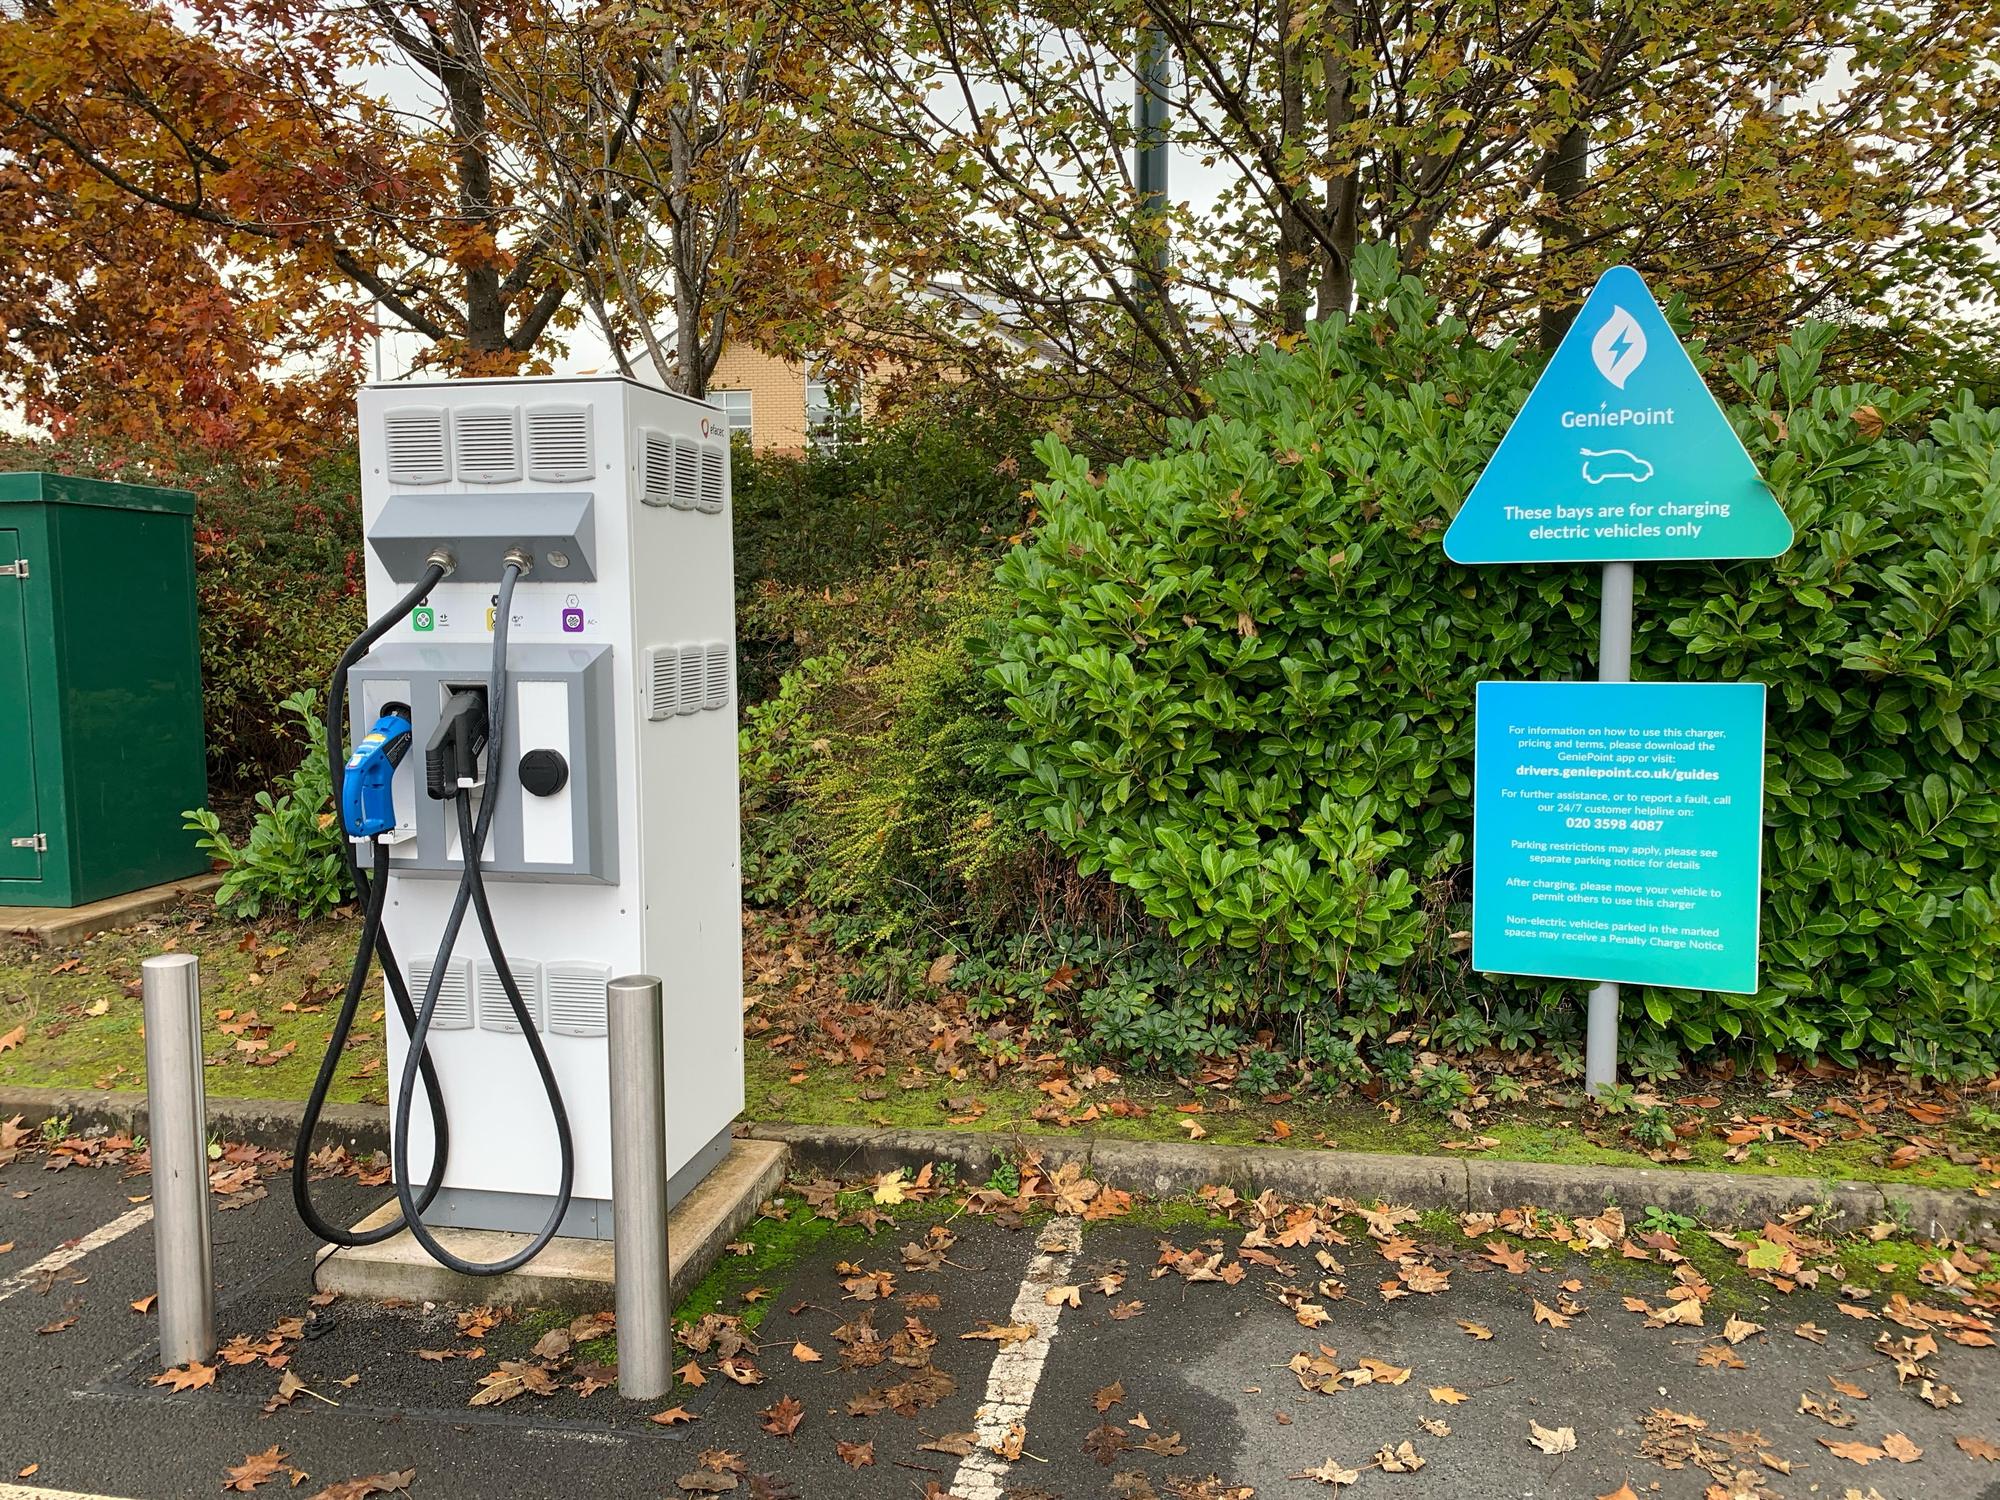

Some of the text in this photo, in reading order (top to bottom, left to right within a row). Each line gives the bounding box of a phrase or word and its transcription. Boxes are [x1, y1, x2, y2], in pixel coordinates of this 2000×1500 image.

[1562, 402, 1674, 428] GeniePoint
[1504, 502, 1730, 520] These bays are for charging
[1529, 523, 1702, 540] electric vehicles only
[1509, 726, 1525, 734] For
[1528, 726, 1585, 735] information
[1604, 727, 1626, 736] how
[1663, 728, 1682, 737] this
[1685, 729, 1726, 739] charger,
[1518, 740, 1715, 751] pricing and terms, please download the
[1558, 753, 1612, 762] GeniePoint
[1617, 755, 1635, 763] app
[1652, 754, 1676, 763] visit:
[1516, 766, 1719, 781] drivers.geniepoint.co.uk/guides
[1502, 789, 1517, 798] For
[1520, 790, 1553, 799] further
[1557, 791, 1610, 801] assistance,
[1641, 795, 1672, 803] report
[1684, 795, 1710, 804] fault,
[1714, 796, 1731, 804] call
[1558, 804, 1581, 813] 24/7
[1585, 806, 1632, 814] customer
[1635, 807, 1674, 816] helpline
[1566, 818, 1663, 831] 020 3598 4087
[1512, 840, 1547, 851] Parking
[1550, 842, 1605, 852] restrictions
[1609, 845, 1628, 854] may
[1632, 846, 1661, 856] apply,
[1665, 847, 1697, 857] please
[1529, 855, 1700, 869] separate parking notice for details
[1506, 878, 1721, 897] After charging, please move your vehicle to
[1532, 893, 1564, 903] permit
[1567, 895, 1598, 903] others
[1636, 898, 1654, 907] this
[1657, 900, 1696, 910] charger
[1506, 915, 1719, 937] Non-electric vehicles parked in the marked
[1504, 929, 1536, 938] spaces
[1539, 931, 1559, 940] may
[1562, 933, 1598, 942] receive
[1609, 935, 1646, 946] Penalty
[1649, 937, 1686, 949] Charge
[1689, 940, 1724, 951] Notice
